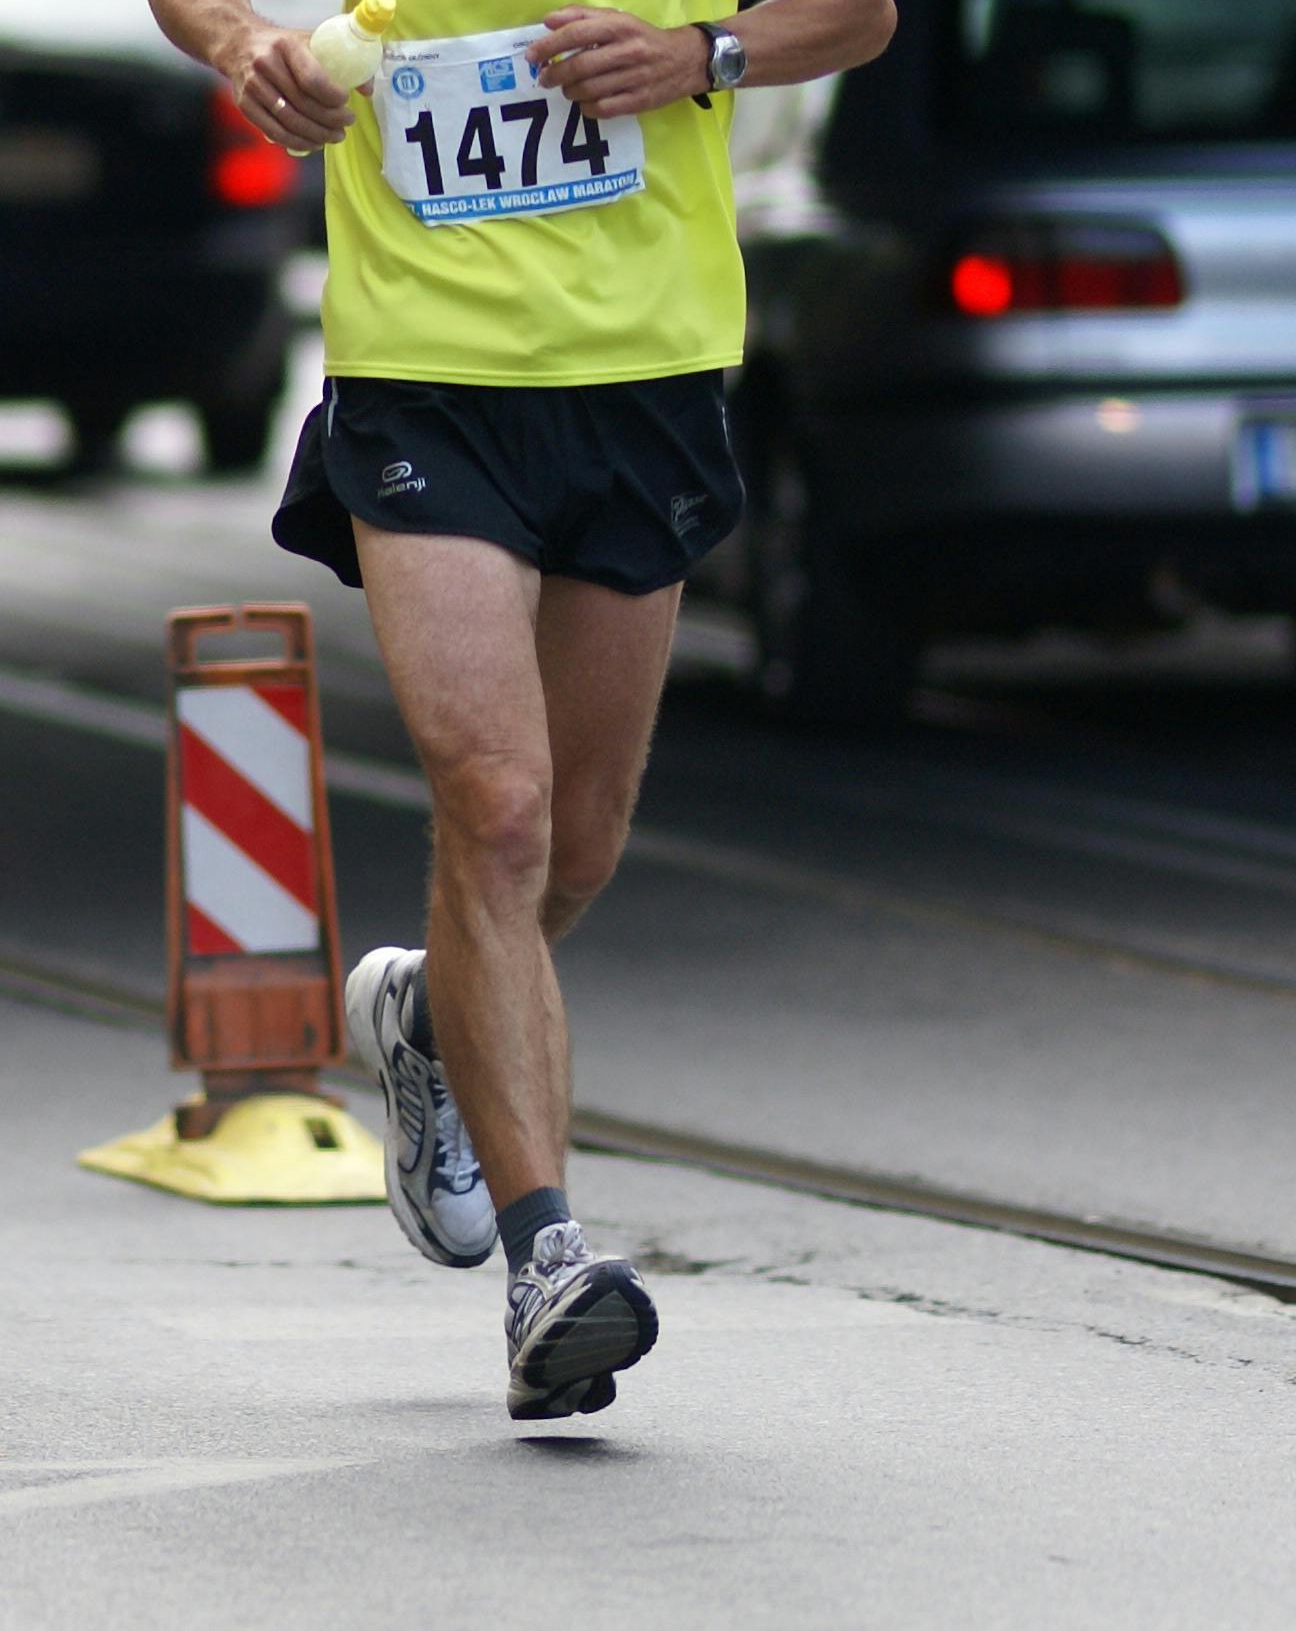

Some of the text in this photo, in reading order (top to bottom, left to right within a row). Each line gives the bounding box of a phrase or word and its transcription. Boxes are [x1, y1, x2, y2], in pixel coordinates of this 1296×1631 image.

[405, 98, 610, 195] 1474
[422, 197, 496, 217] HASCO-LEK
[573, 173, 636, 198] MARATON
